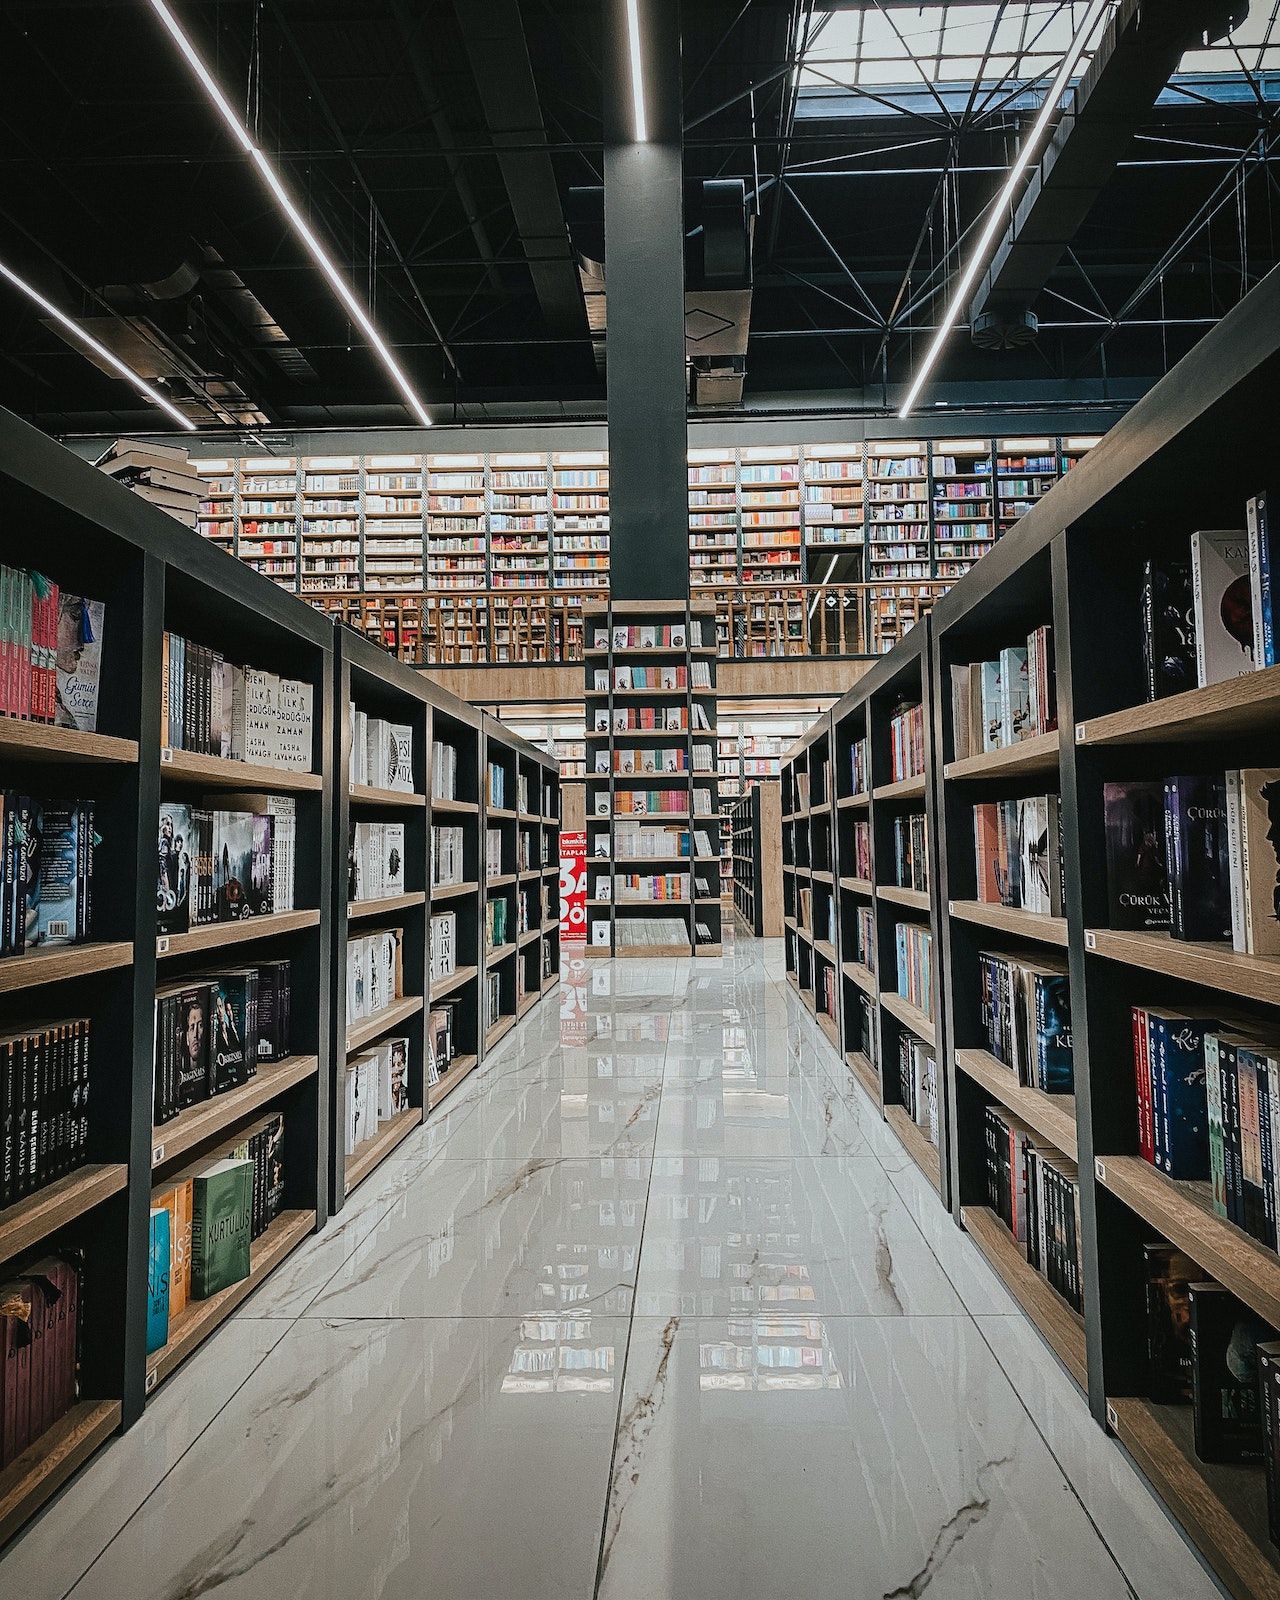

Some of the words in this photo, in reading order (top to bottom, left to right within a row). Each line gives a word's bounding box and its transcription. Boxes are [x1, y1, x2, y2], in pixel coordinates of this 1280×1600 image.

[249, 704, 277, 717] RDÜĞÜM
[276, 710, 311, 723] ÖRDÜĞÜM
[249, 720, 269, 730] AMAN
[276, 725, 303, 736] ZAMAN
[249, 738, 266, 747] ASHA
[248, 748, 271, 758] VANAGH
[560, 857, 576, 898] 3
[575, 871, 587, 894] A
[440, 920, 450, 935] 13
